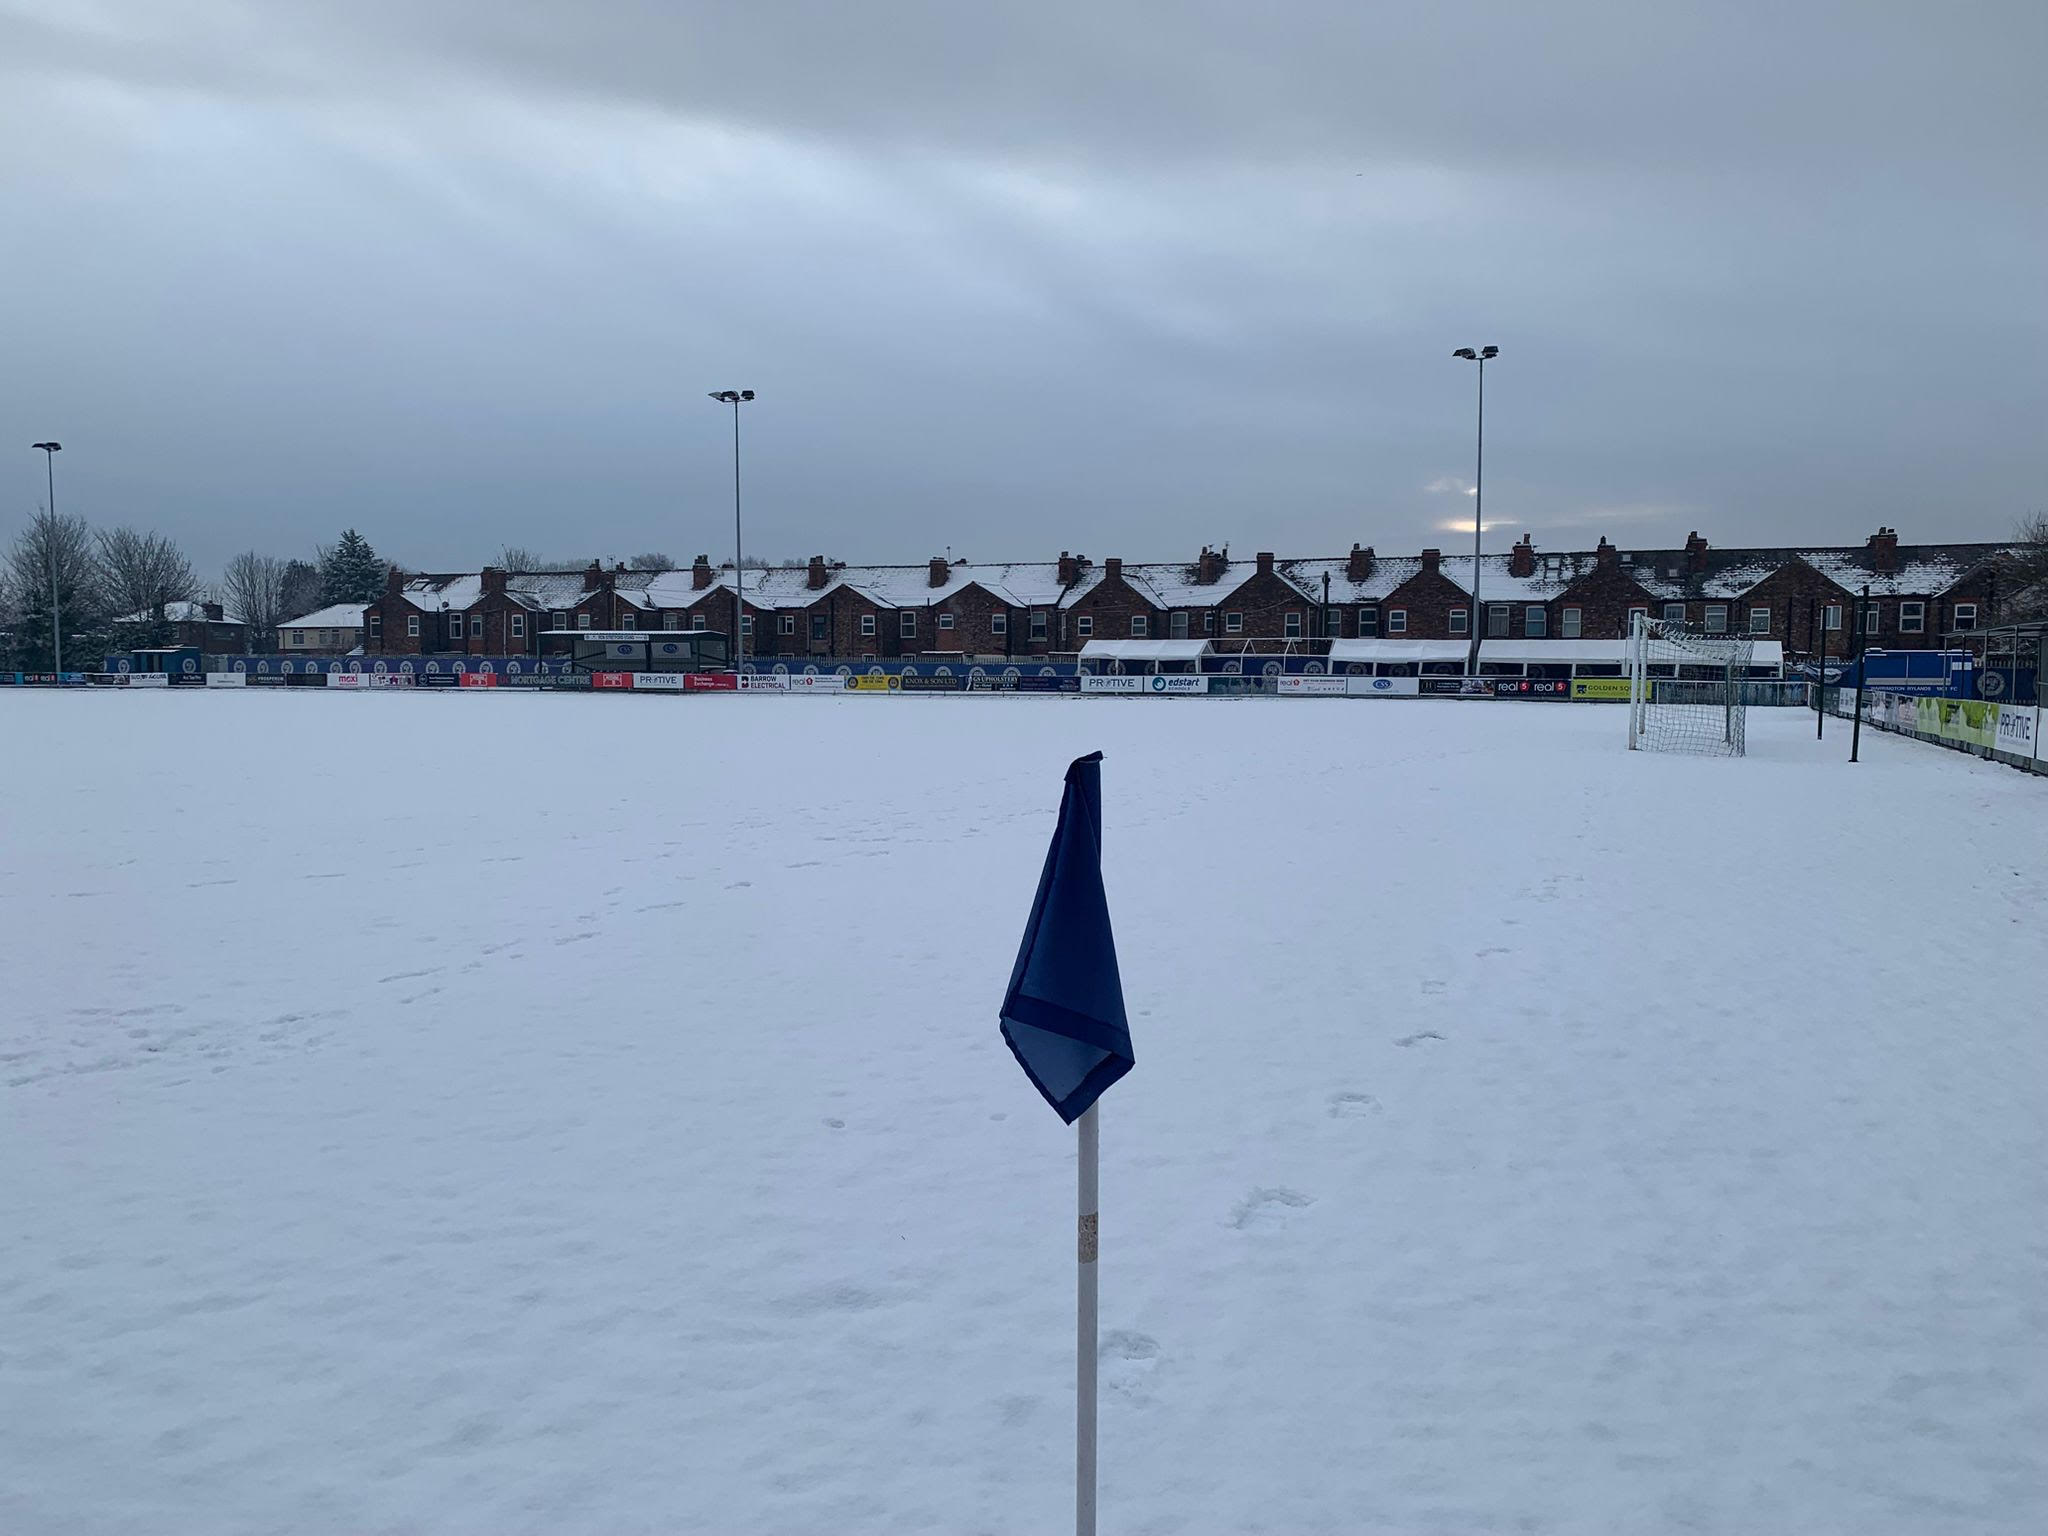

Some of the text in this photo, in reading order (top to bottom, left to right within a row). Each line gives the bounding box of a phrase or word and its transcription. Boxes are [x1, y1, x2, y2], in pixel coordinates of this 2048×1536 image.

[510, 675, 557, 685] MORTGAGE
[557, 675, 590, 685] CENTRE
[930, 678, 945, 686] SON
[1168, 677, 1200, 687] edstart
[1498, 681, 1519, 692] real
[1534, 682, 1554, 692] real
